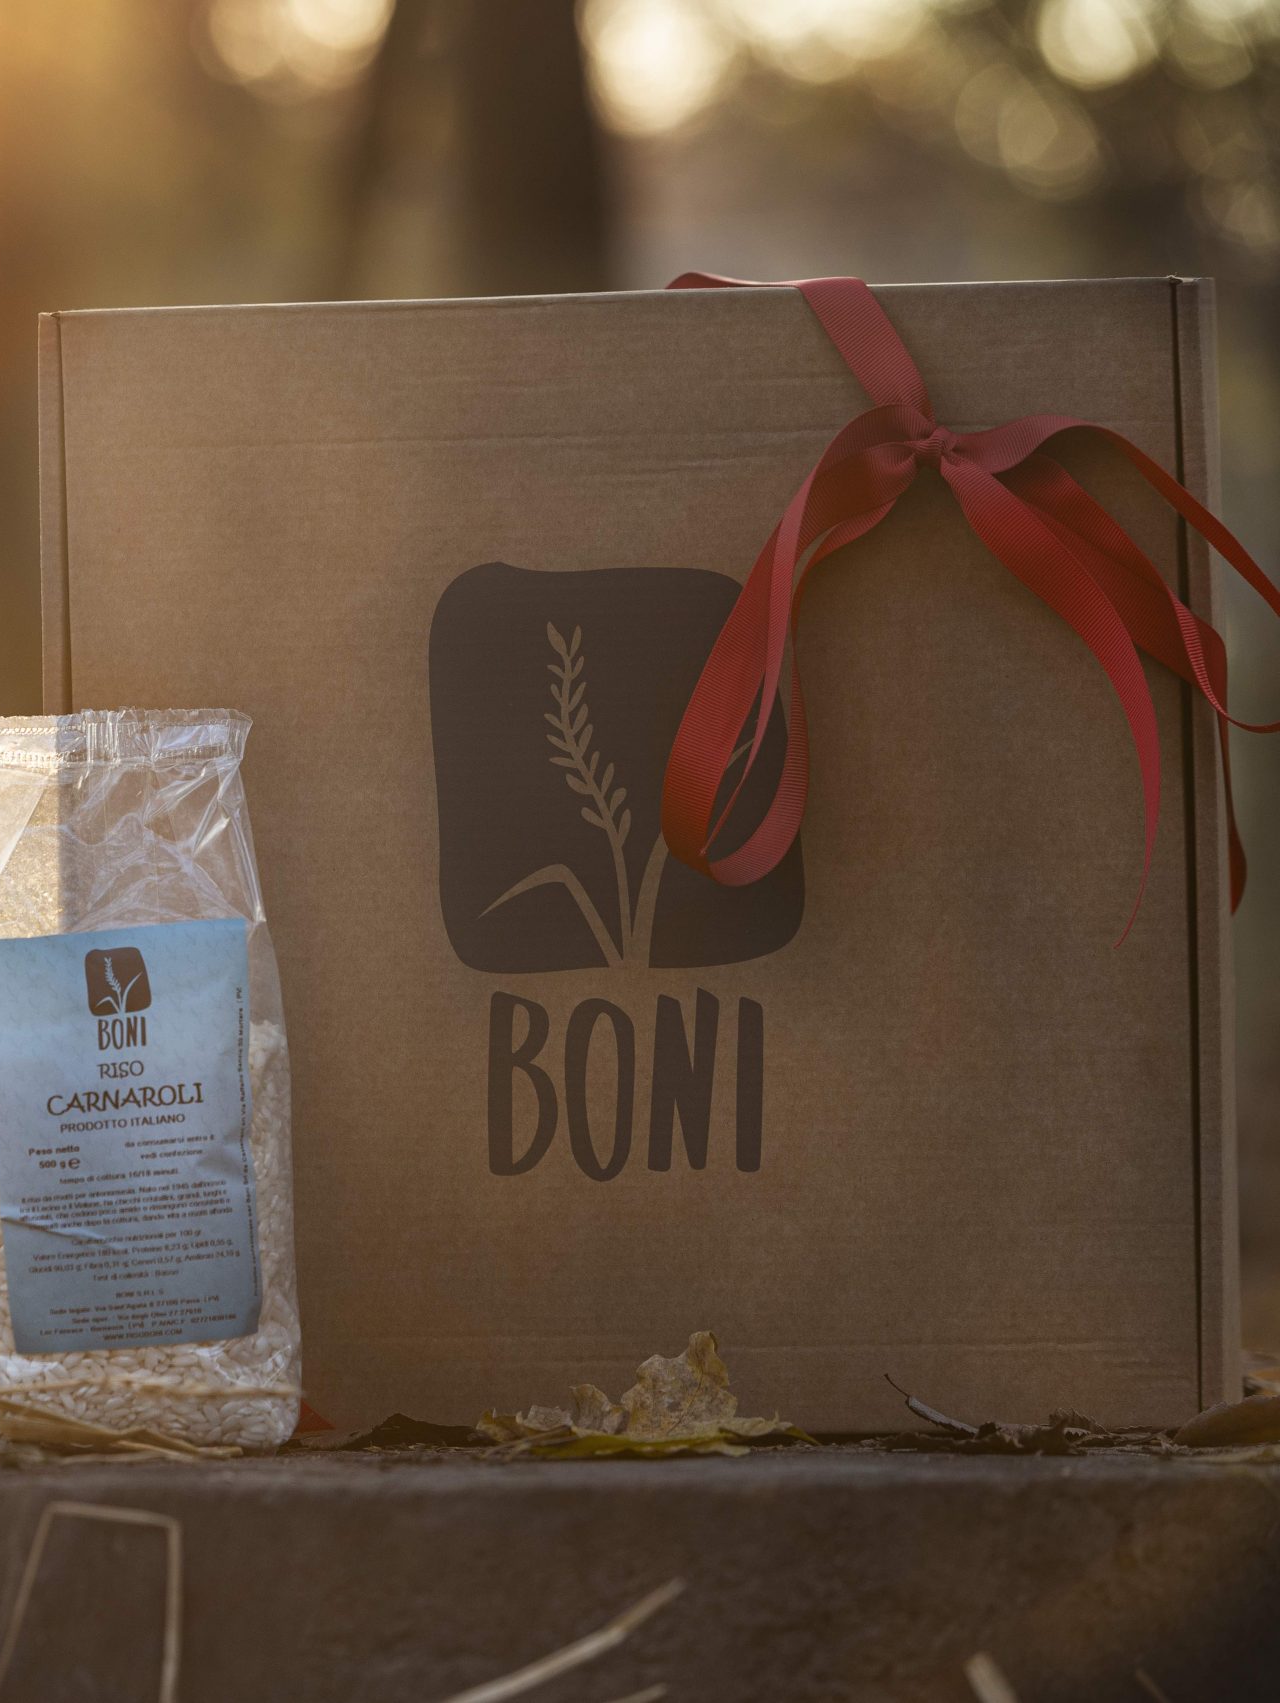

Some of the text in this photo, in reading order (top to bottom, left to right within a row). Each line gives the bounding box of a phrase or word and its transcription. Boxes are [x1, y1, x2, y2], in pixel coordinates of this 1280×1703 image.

[98, 1016, 147, 1050] BONI
[97, 1060, 144, 1079] RISO
[487, 986, 764, 1182] BONI
[47, 1082, 204, 1116] CARNAROLI
[60, 1114, 186, 1133] PRODOTTO ITALIANO
[28, 1145, 80, 1156] Peso netto
[39, 1160, 56, 1169] 500
